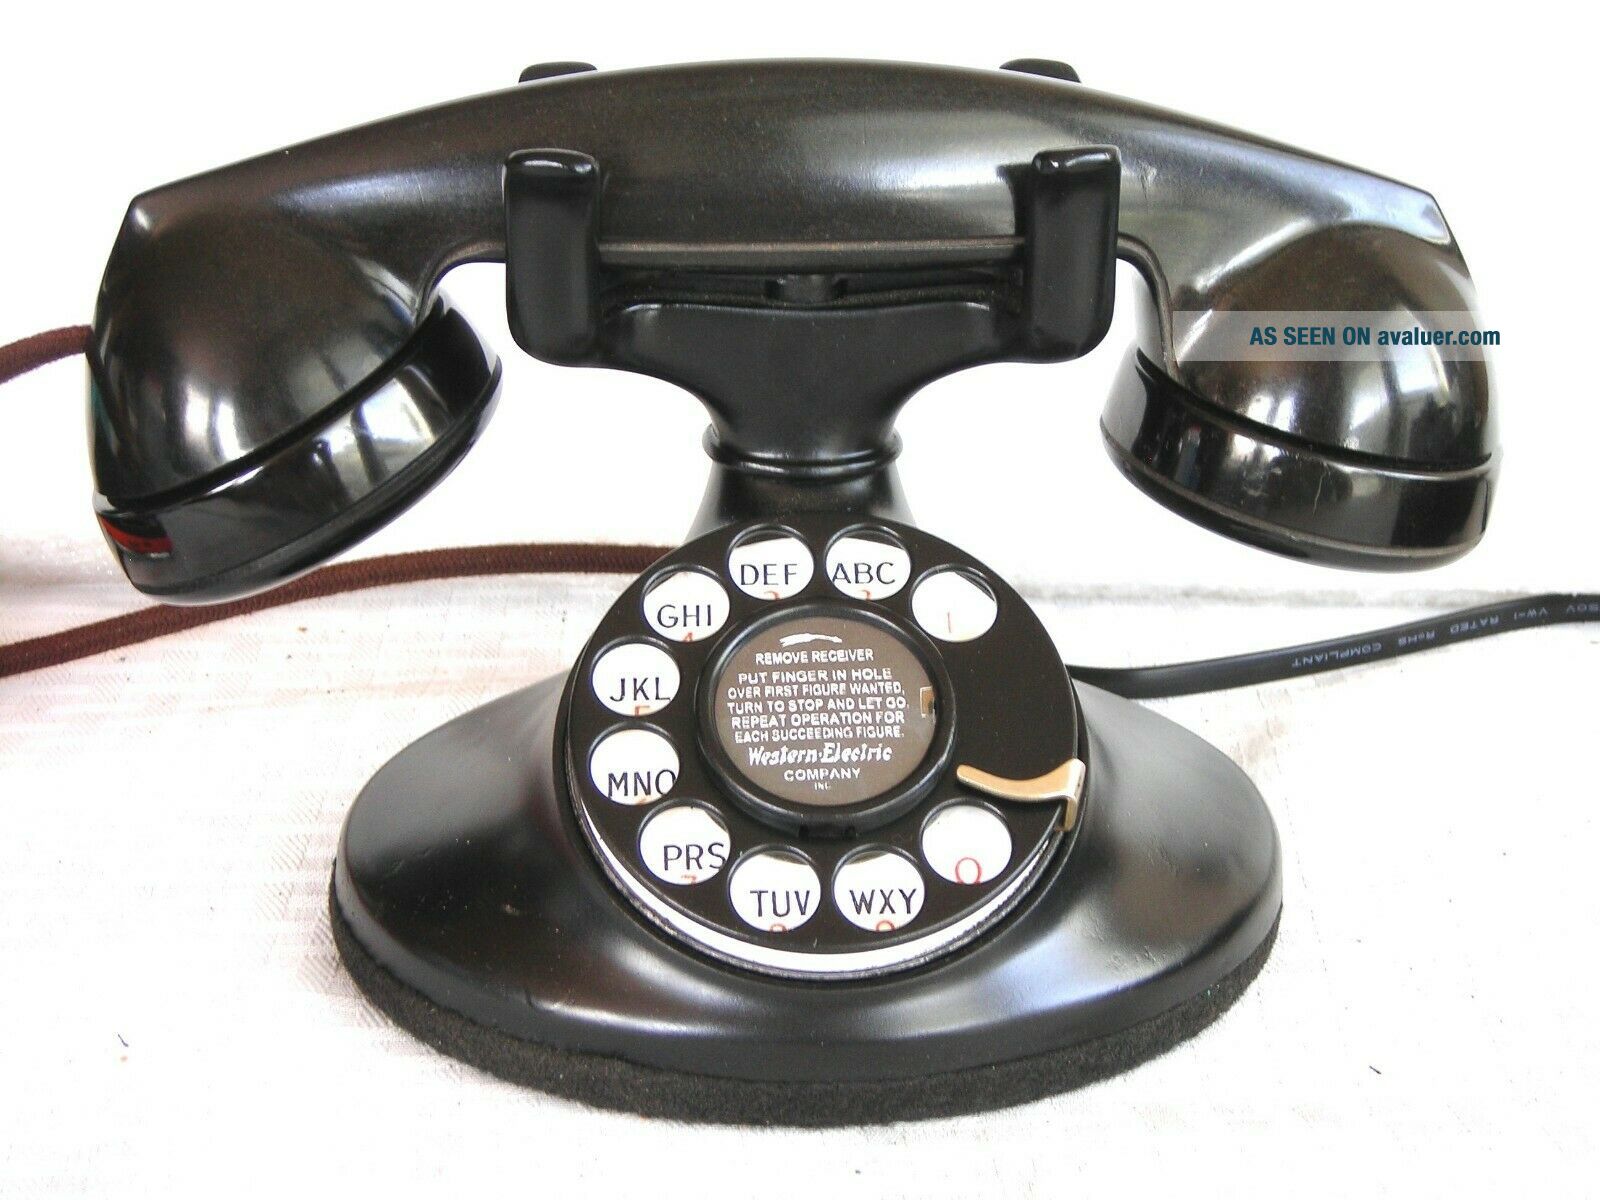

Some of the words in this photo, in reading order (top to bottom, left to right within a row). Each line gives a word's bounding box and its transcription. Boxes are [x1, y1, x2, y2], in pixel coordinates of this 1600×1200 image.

[740, 562, 798, 587] DEF
[831, 561, 896, 586] ABC
[656, 604, 712, 629] GHI
[1450, 615, 1499, 634] RATED
[1398, 630, 1435, 647] RoHS
[755, 651, 809, 666] REMOVE
[811, 648, 874, 663] RECEIVER
[1291, 642, 1383, 668] COMPLIANT
[738, 671, 768, 685] PUT
[772, 669, 828, 684] FINGER
[832, 669, 847, 682] IN
[851, 667, 892, 681] HOLE
[609, 676, 671, 703] JKL
[727, 686, 761, 700] OVER
[764, 684, 799, 698] FIRST
[802, 682, 846, 697] FIGURE
[727, 701, 763, 715] TURN
[767, 700, 785, 713] TO
[788, 698, 824, 713] STOP
[827, 697, 855, 711] AND
[858, 696, 882, 710] LET
[731, 714, 786, 730] REPEAT
[790, 711, 872, 728] OPERATION
[875, 710, 905, 725] FOR
[734, 730, 769, 744] EACH
[771, 726, 854, 742] SUCCEEDING
[856, 725, 904, 739] FIGURE.
[608, 768, 677, 801] MNO
[783, 767, 861, 782] COMPANY
[663, 842, 726, 872] PRS
[750, 889, 810, 918] TUV
[850, 888, 917, 915] WXY
